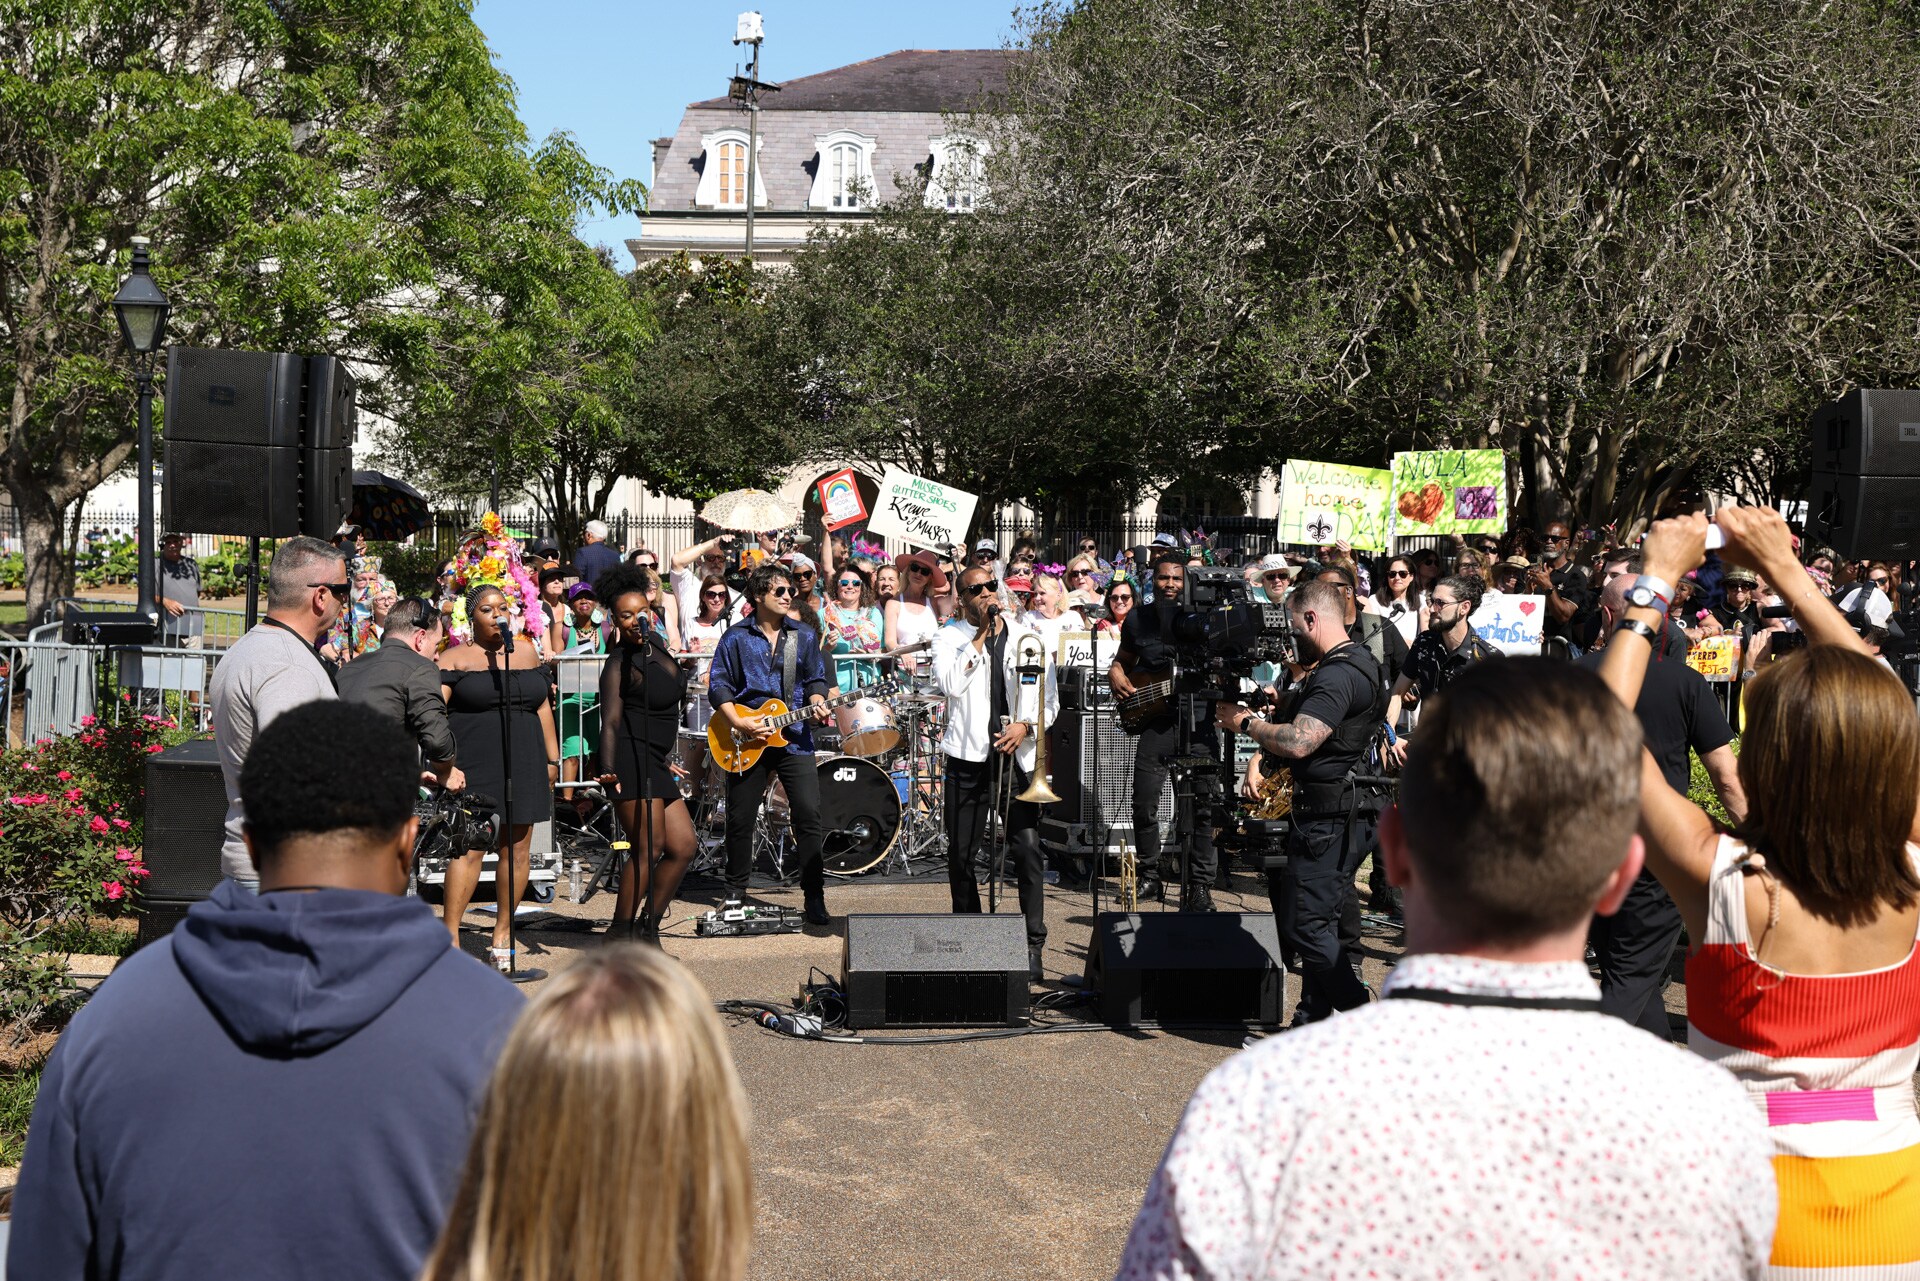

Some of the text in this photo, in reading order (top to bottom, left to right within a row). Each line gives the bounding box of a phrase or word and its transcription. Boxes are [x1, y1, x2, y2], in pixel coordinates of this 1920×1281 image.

[1289, 460, 1382, 490] Welcome
[1400, 451, 1468, 480] NOLA
[892, 484, 957, 513] GLITTER SHOES
[911, 479, 943, 497] MUSES
[1304, 486, 1367, 510] home
[888, 495, 937, 521] Krewe
[906, 519, 952, 542] Muses
[833, 767, 857, 782] dw
